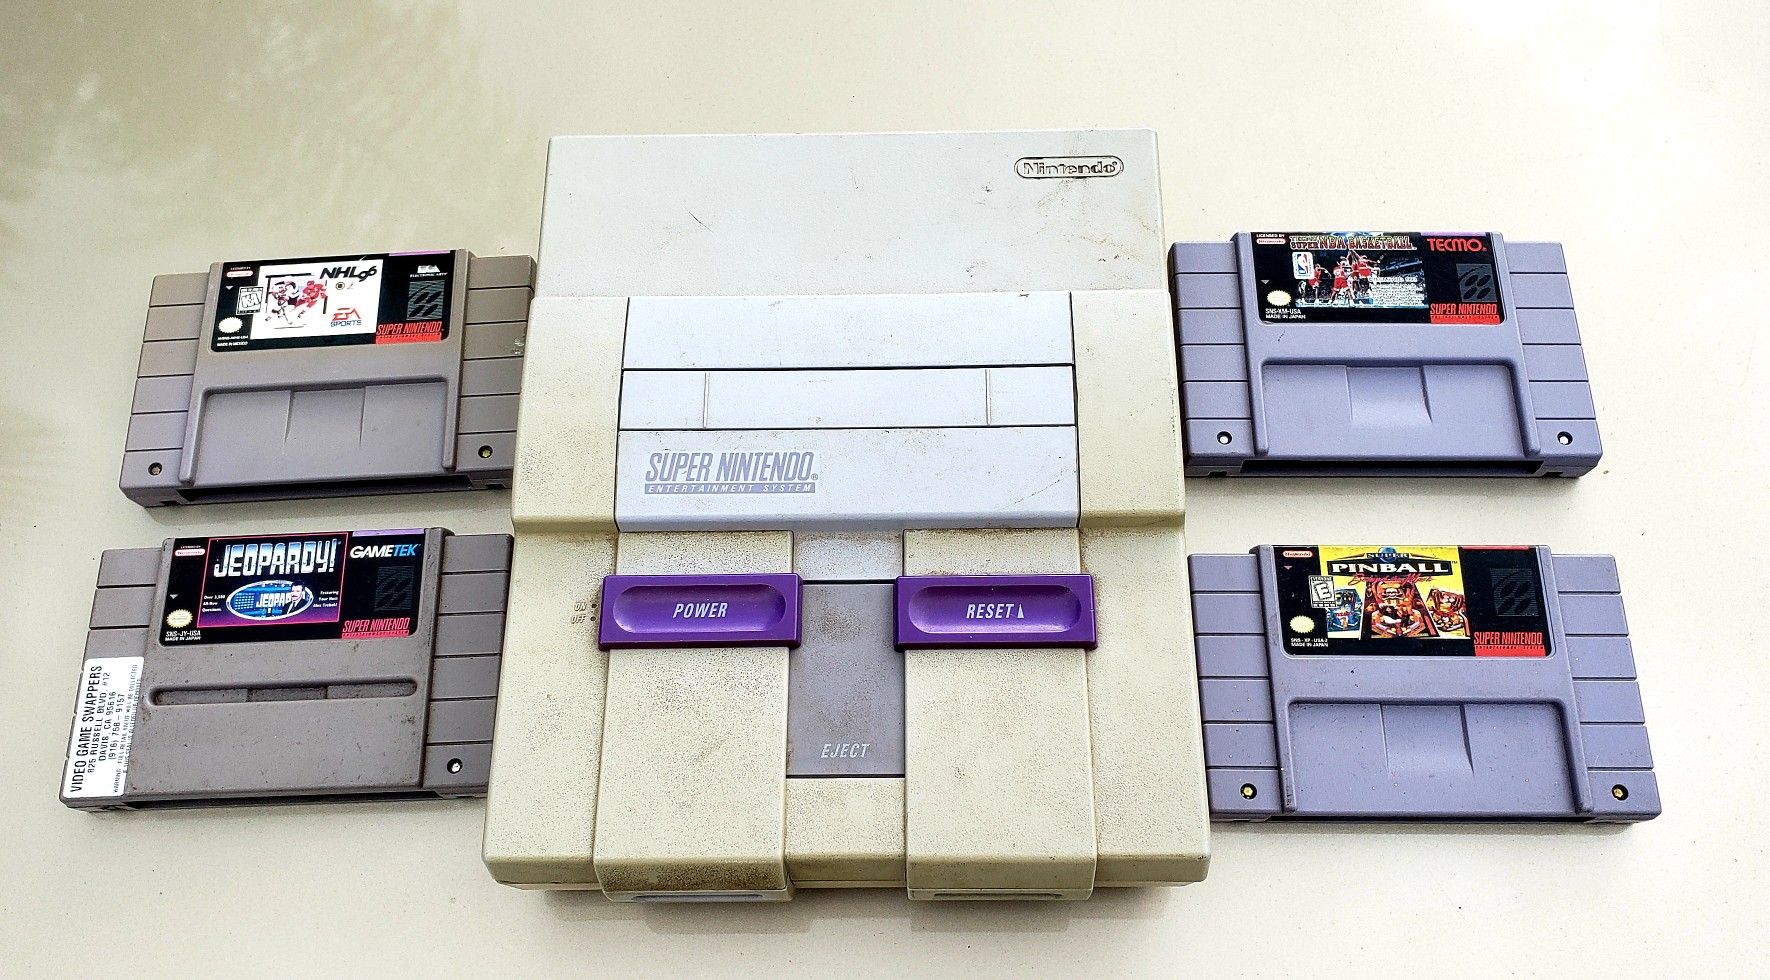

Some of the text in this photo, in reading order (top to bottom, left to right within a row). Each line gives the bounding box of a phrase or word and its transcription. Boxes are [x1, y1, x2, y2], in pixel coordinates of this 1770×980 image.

[1023, 161, 1114, 175] Nintendo
[1318, 235, 1413, 250] NBA BASKETBALL
[1426, 238, 1483, 252] TECMO
[332, 307, 362, 321] EA
[1429, 303, 1498, 315] SUPER NINTENDO
[330, 319, 362, 328] SPORTS
[376, 321, 443, 336] SUPER NINTENDO
[645, 452, 714, 482] SUPER
[648, 483, 813, 494] ENTERTAINMENT SYSTEM
[213, 539, 338, 578] JEOPARDY!
[349, 544, 418, 559] GAMETEK
[1331, 563, 1450, 573] PINBALL
[1315, 582, 1332, 600] E
[573, 602, 587, 611] ON
[672, 602, 729, 619] POWER
[966, 603, 1014, 619] RESET
[342, 617, 410, 633] SUPER NINTENDO
[571, 615, 586, 624] OFF
[1473, 631, 1543, 645] SUPER NINTENDO
[106, 691, 117, 716] 95616
[70, 665, 103, 793] VIDEO GAME SWAPPERS
[103, 718, 112, 730] CA
[108, 739, 118, 760] (916)
[116, 693, 125, 717] 9157
[90, 718, 104, 756] RUSSELL
[820, 743, 871, 759] EJECT
